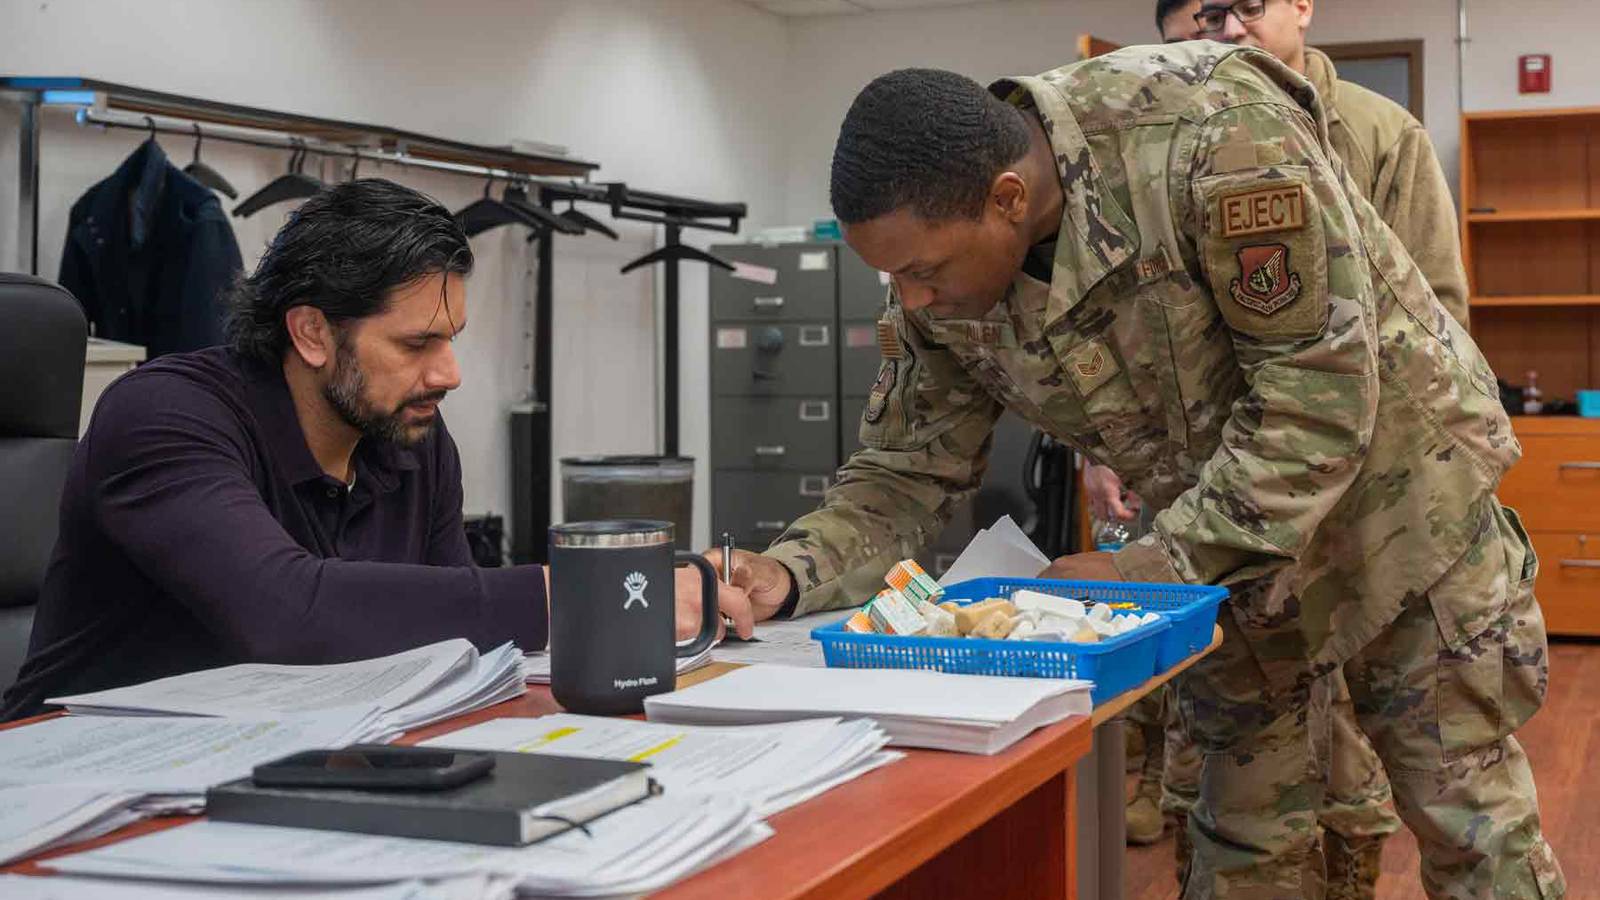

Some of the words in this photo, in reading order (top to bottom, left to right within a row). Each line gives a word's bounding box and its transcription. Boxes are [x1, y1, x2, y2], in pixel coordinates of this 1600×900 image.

[1227, 191, 1298, 231] EJECT
[614, 678, 638, 690] Hydro
[639, 676, 658, 686] Flask
